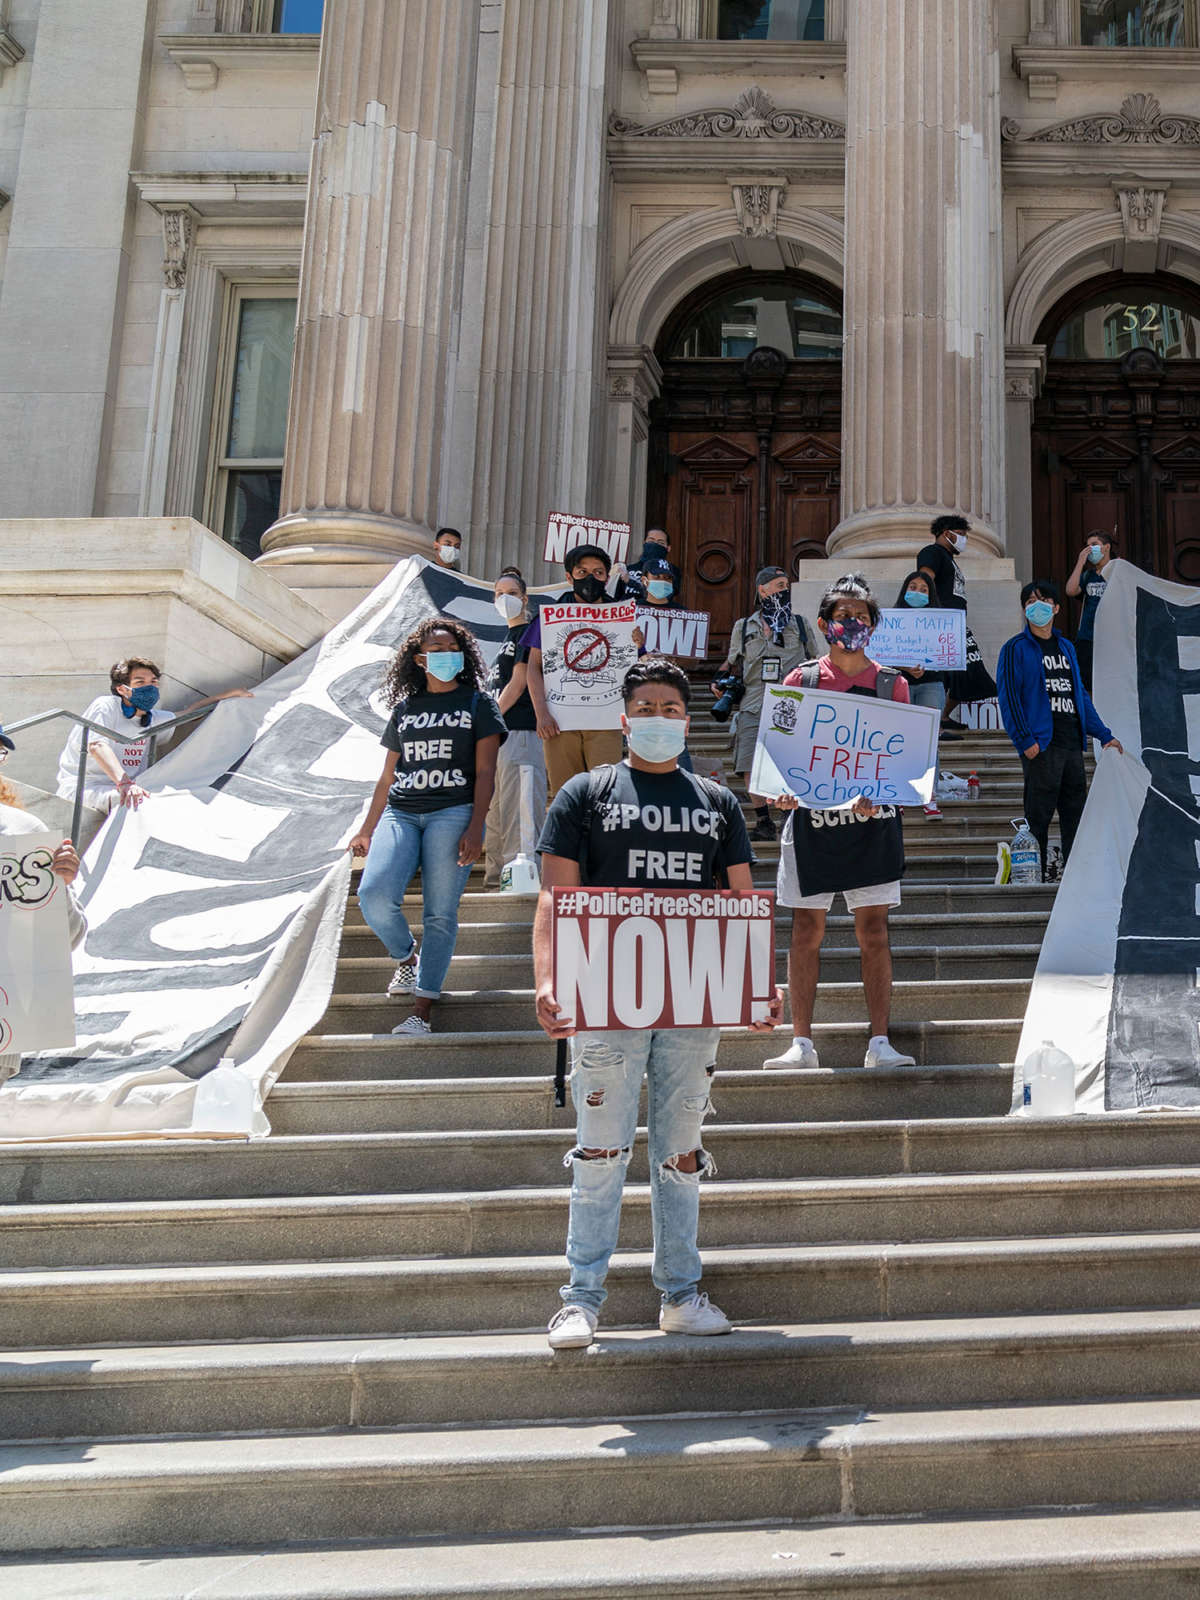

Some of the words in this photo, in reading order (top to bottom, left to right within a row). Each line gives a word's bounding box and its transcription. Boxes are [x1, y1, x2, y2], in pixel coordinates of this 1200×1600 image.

[1122, 305, 1159, 331] 52
[549, 512, 631, 533] #PoliceFreeSchools
[636, 614, 709, 658] OW!
[884, 616, 906, 631] NYC
[915, 616, 955, 631] MATH
[809, 703, 905, 755] Police
[403, 738, 453, 762] FREE
[809, 745, 893, 781] FREE
[782, 767, 897, 801] Schools
[628, 849, 703, 881] FREE
[557, 891, 771, 918] #PoliceFreeSchools
[556, 916, 772, 1029] NOW!
